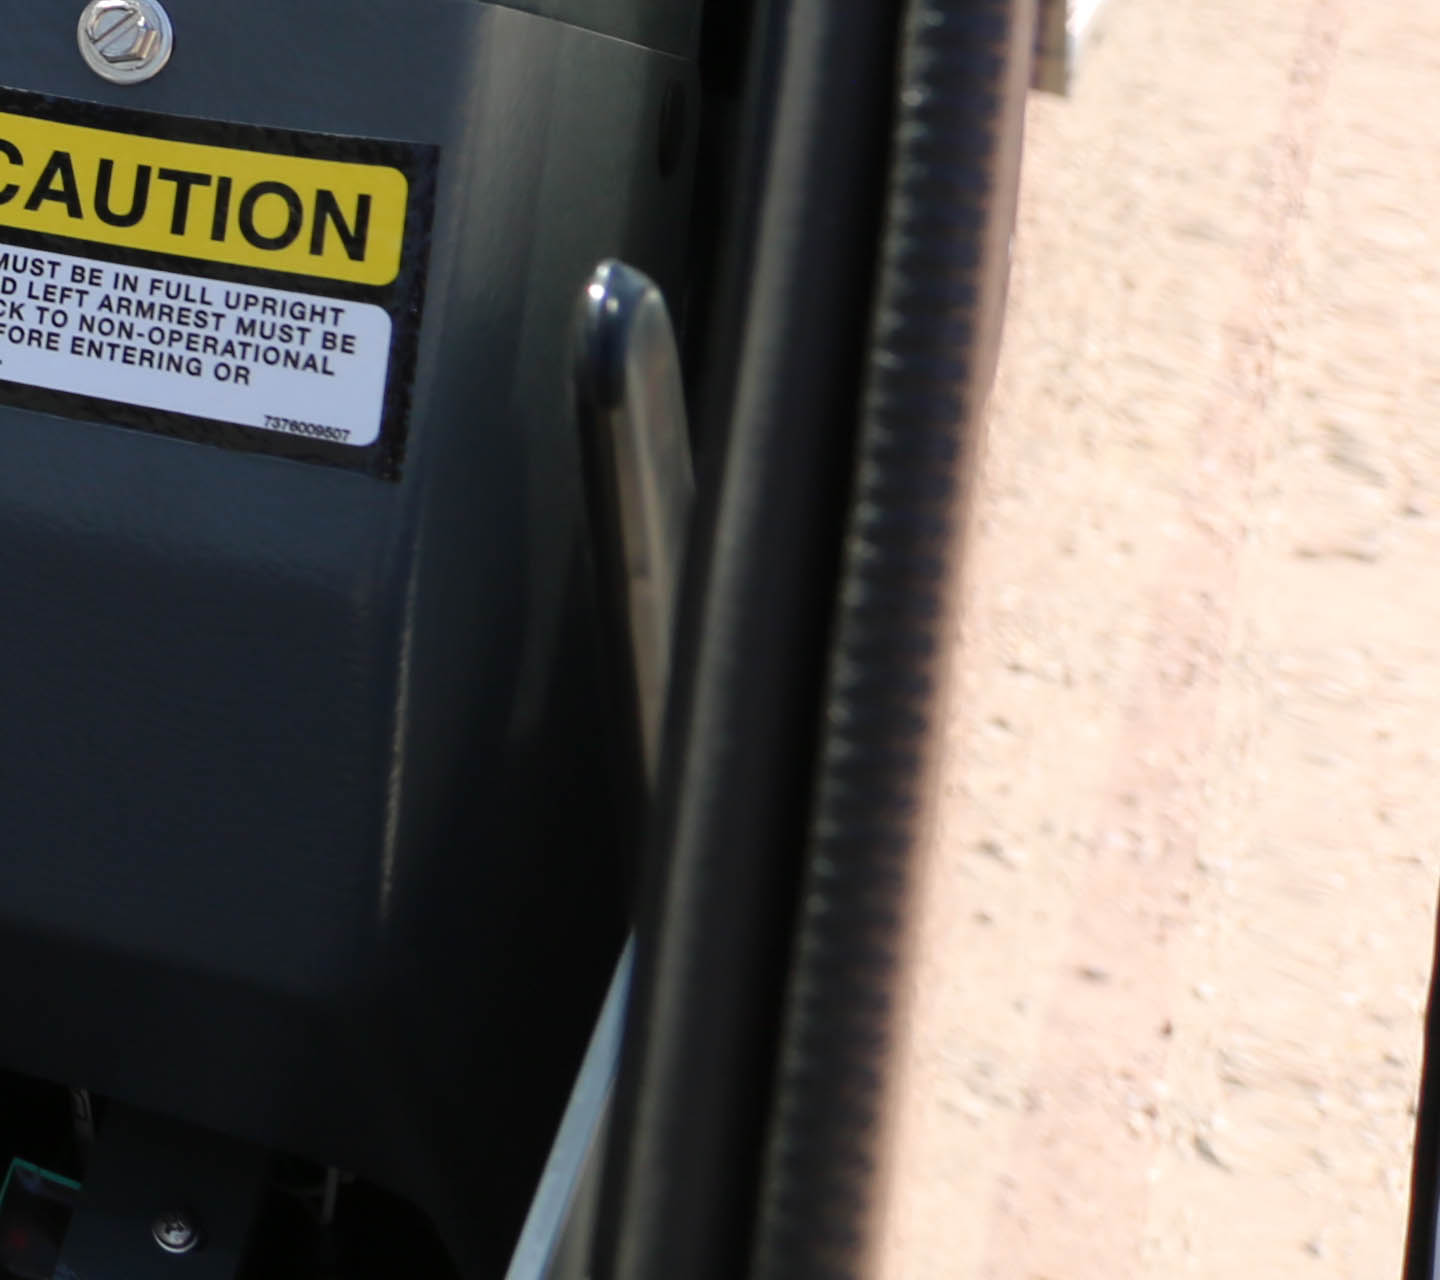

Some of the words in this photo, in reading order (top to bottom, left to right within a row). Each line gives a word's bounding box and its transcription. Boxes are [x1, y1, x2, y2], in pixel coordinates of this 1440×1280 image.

[26, 280, 90, 308] LEFT
[96, 293, 226, 331] ARMREST
[234, 315, 311, 346] MUST
[320, 330, 356, 354] BE
[69, 263, 103, 287] BE
[112, 271, 139, 293] IN
[148, 277, 213, 306] FULL
[224, 289, 345, 326] UPRIGHT
[35, 304, 68, 328] TO
[77, 313, 335, 376] NON-OPERATIONAL
[69, 335, 202, 377] ENTERING
[213, 361, 250, 386] OR
